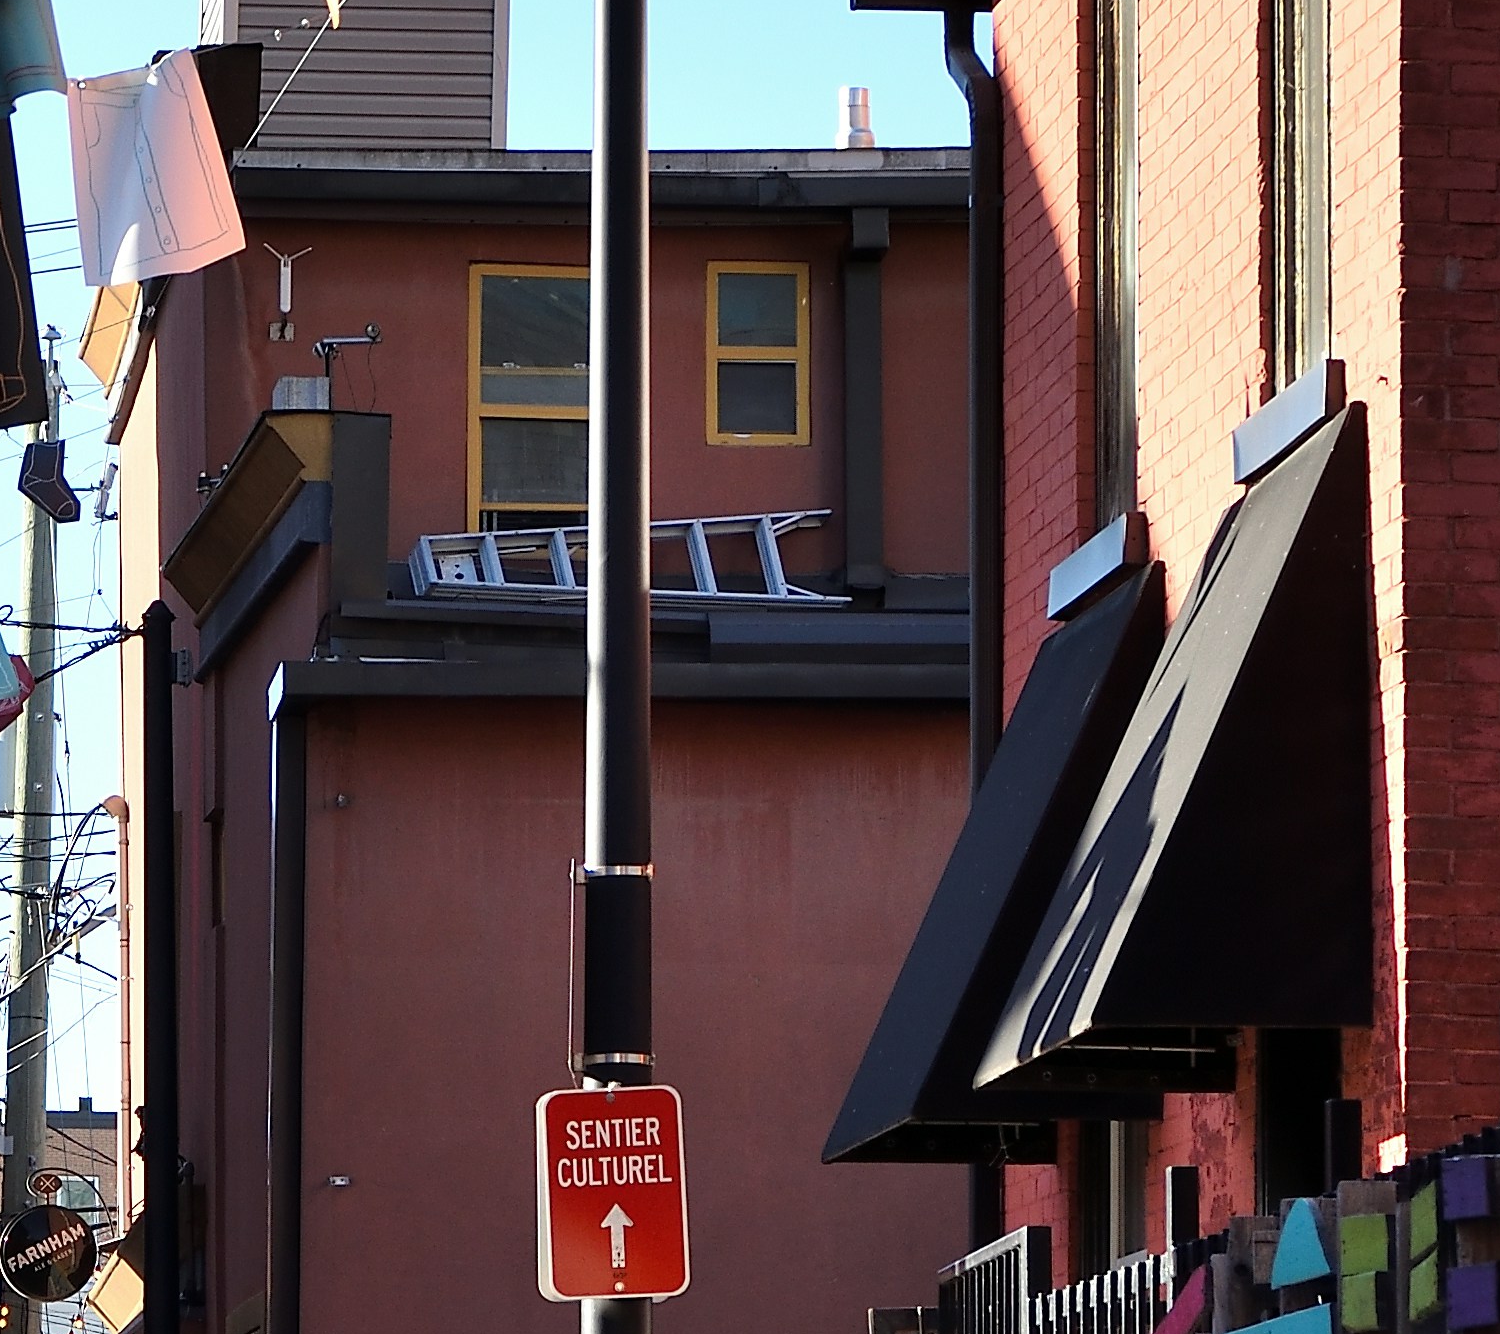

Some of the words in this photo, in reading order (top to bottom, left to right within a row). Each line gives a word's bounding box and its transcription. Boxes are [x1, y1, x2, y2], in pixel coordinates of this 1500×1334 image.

[565, 1117, 661, 1150] SENTIER
[557, 1154, 672, 1188] CULTUREL
[7, 1223, 86, 1273] FARNHAM
